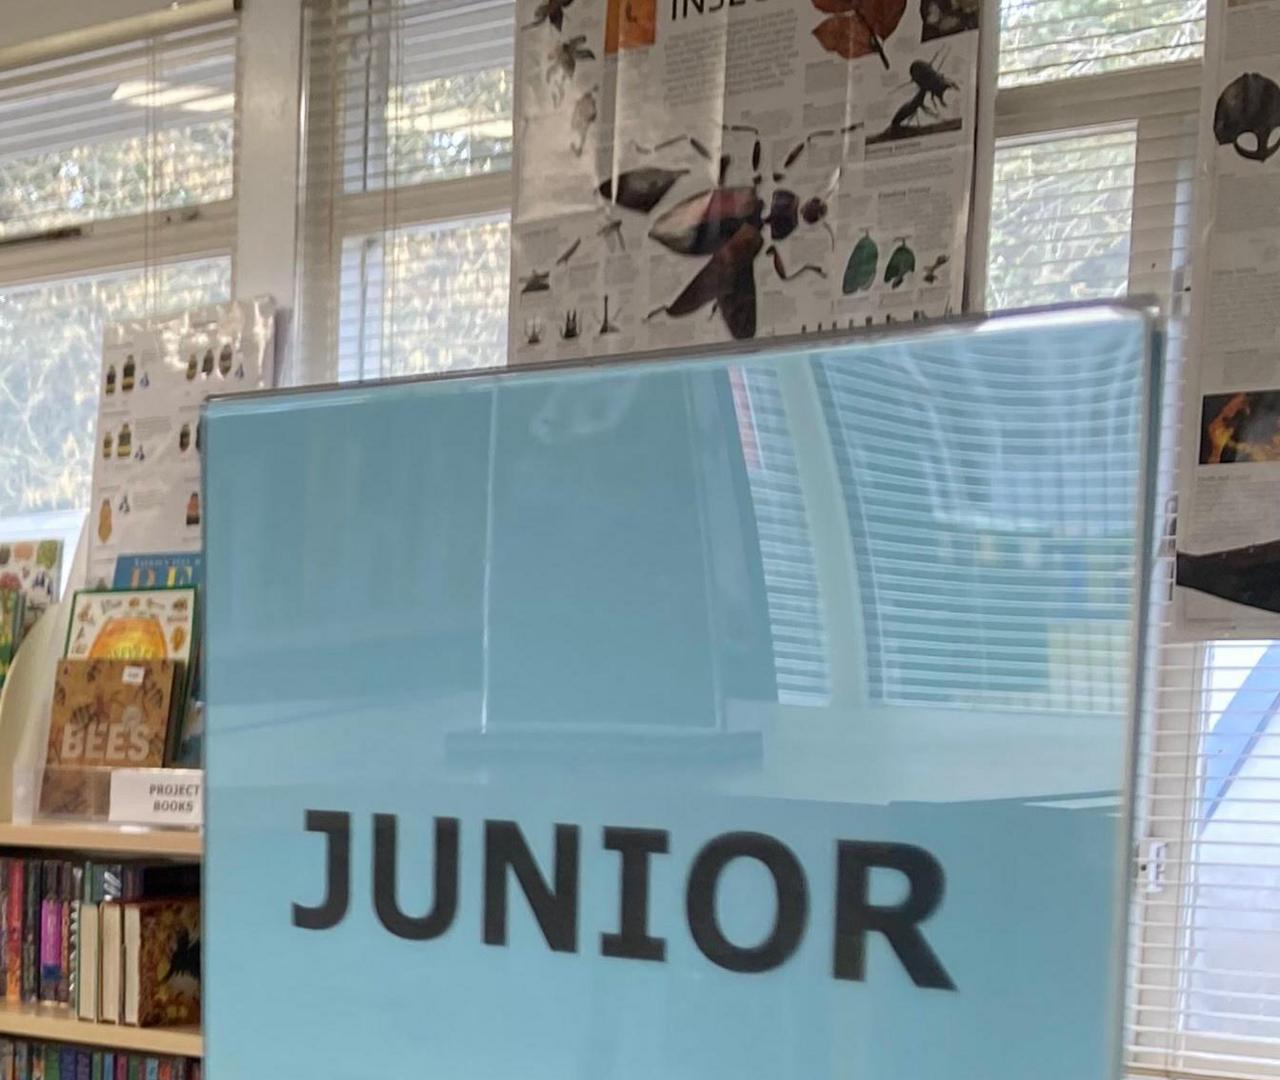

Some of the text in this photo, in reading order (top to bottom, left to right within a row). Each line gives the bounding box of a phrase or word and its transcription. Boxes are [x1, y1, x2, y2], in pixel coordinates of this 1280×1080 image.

[60, 720, 151, 762] BEES
[148, 783, 201, 798] PROJECT
[152, 799, 195, 813] BOOKS
[291, 808, 958, 992] JUNIOR
